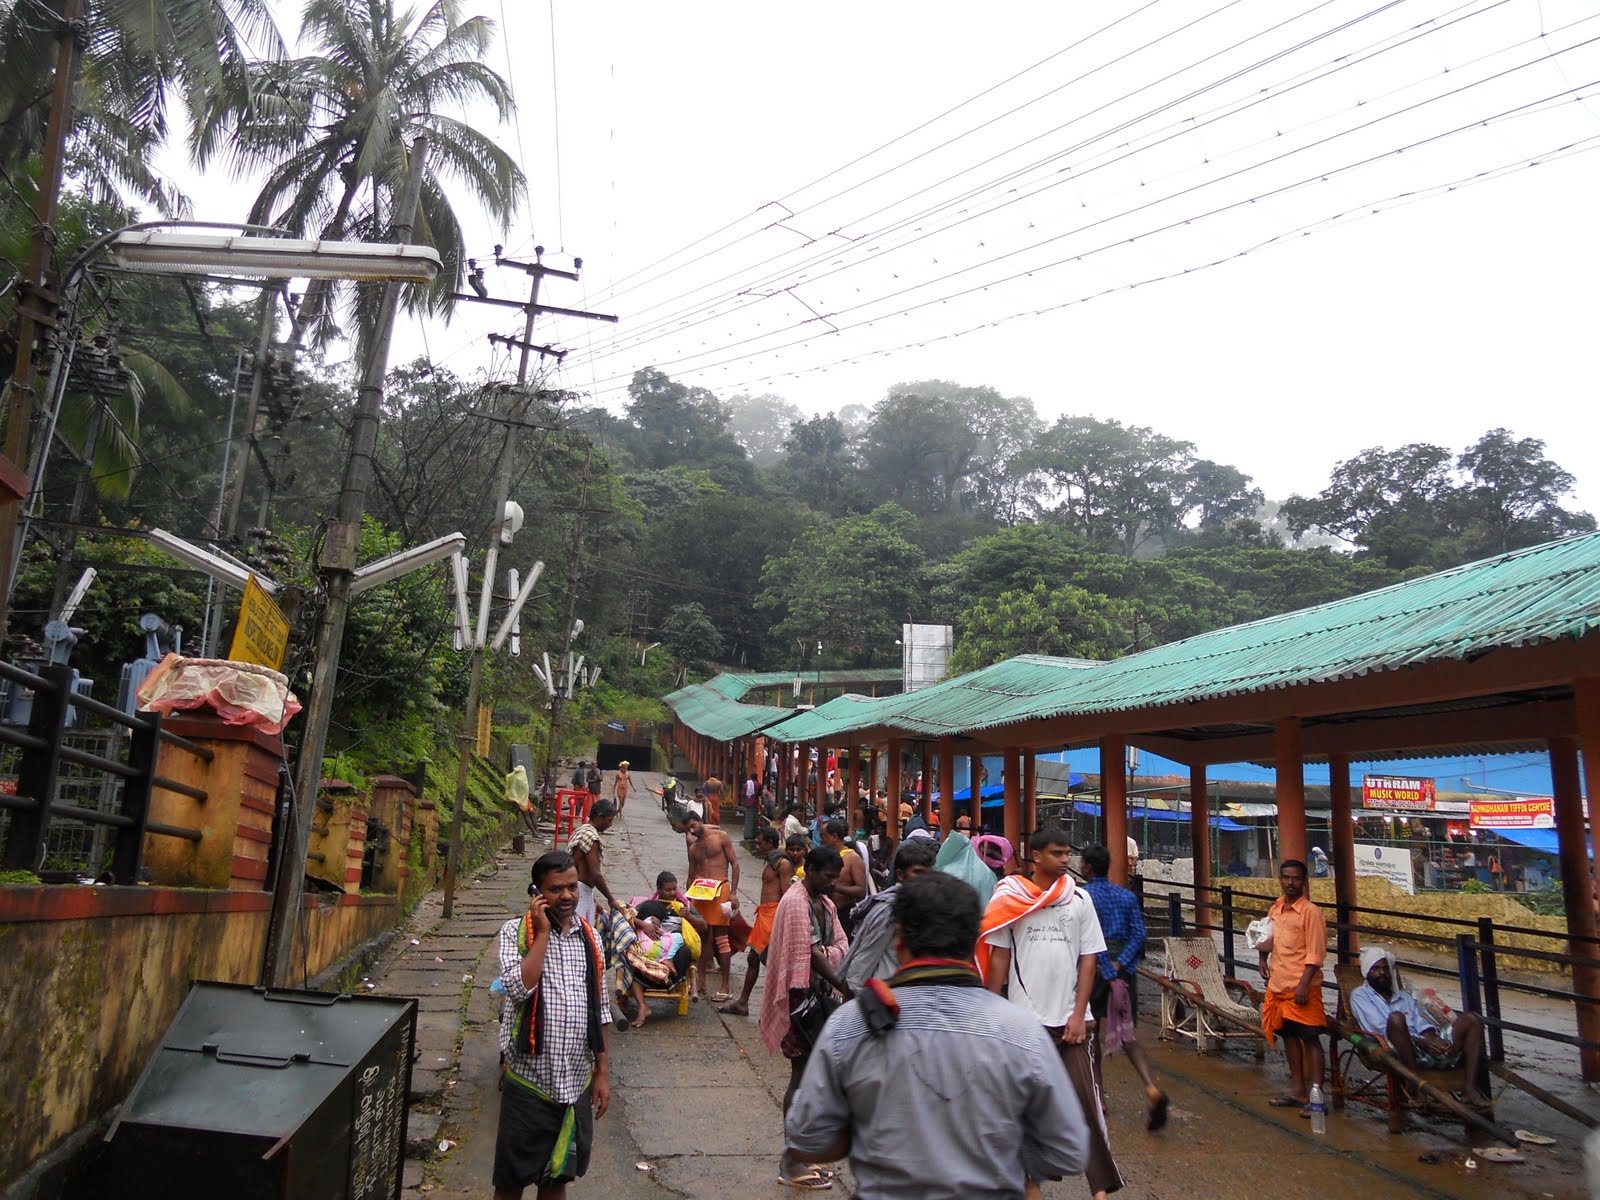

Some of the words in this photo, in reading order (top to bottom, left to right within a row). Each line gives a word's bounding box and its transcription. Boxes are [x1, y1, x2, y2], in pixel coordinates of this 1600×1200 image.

[1366, 778, 1420, 789] UTHRAM
[1369, 789, 1393, 799] MUSIC
[1394, 791, 1420, 800] WORLD
[1509, 803, 1527, 812] TIFFIN
[1528, 802, 1551, 812] CENTRE
[385, 1076, 396, 1127] SOLID
